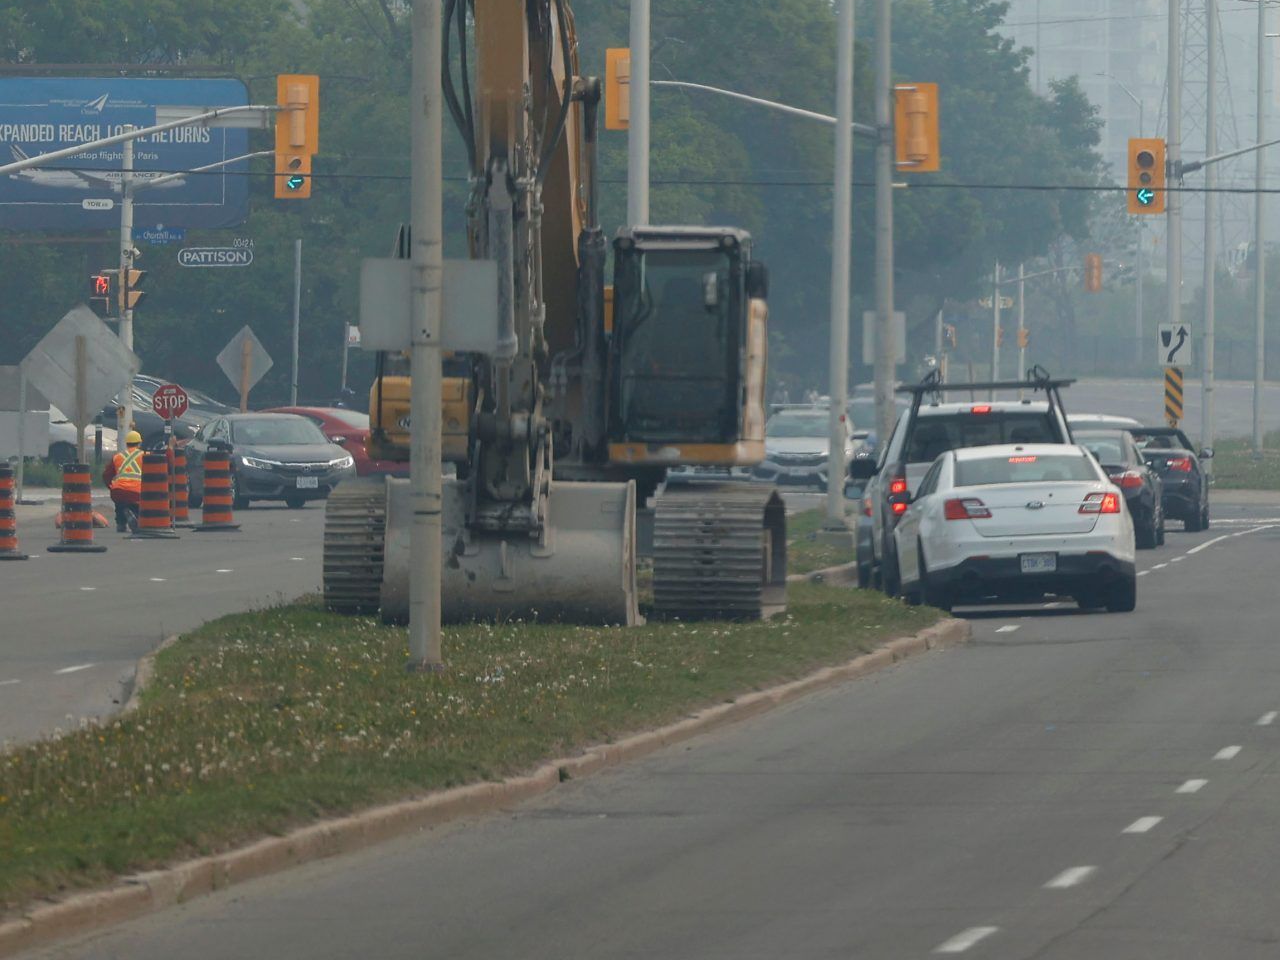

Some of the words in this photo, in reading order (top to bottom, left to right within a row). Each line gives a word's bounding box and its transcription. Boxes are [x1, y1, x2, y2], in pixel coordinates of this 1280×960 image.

[138, 151, 159, 159] Paris
[183, 251, 247, 262] PATTISON
[154, 395, 185, 409] STOP
